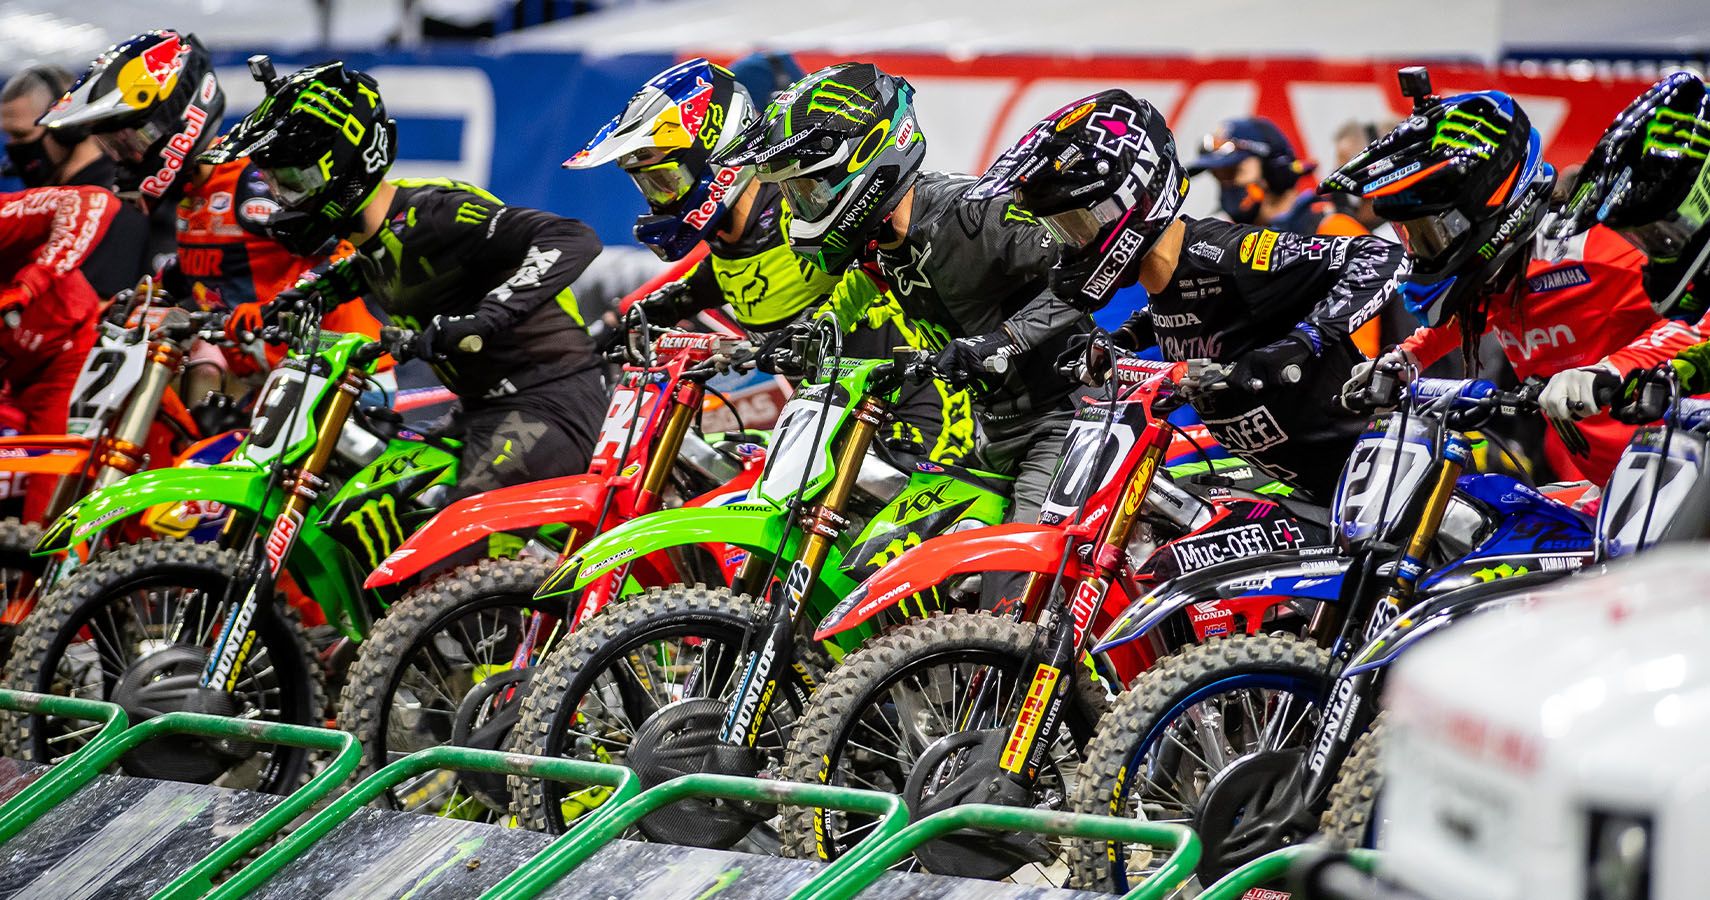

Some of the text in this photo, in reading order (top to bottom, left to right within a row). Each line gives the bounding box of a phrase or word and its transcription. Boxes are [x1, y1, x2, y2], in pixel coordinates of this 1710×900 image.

[898, 123, 913, 148] BELL
[1114, 138, 1160, 210] FLY
[1087, 230, 1143, 295] Muc-Off
[1542, 267, 1586, 289] YAMAHA
[68, 350, 127, 419] 2
[1125, 458, 1154, 516] FMF
[726, 504, 773, 513] TOMAC
[1183, 528, 1266, 574] Muc-Off
[1299, 547, 1335, 556] STEWART
[876, 582, 911, 607] POWER
[1193, 608, 1233, 622] HONDA
[1204, 622, 1228, 636] HRC
[731, 638, 776, 746] DUNLOP
[1007, 668, 1056, 767] PIRELLI
[1042, 697, 1063, 735] GALFER
[1339, 693, 1362, 743] BRAKING
